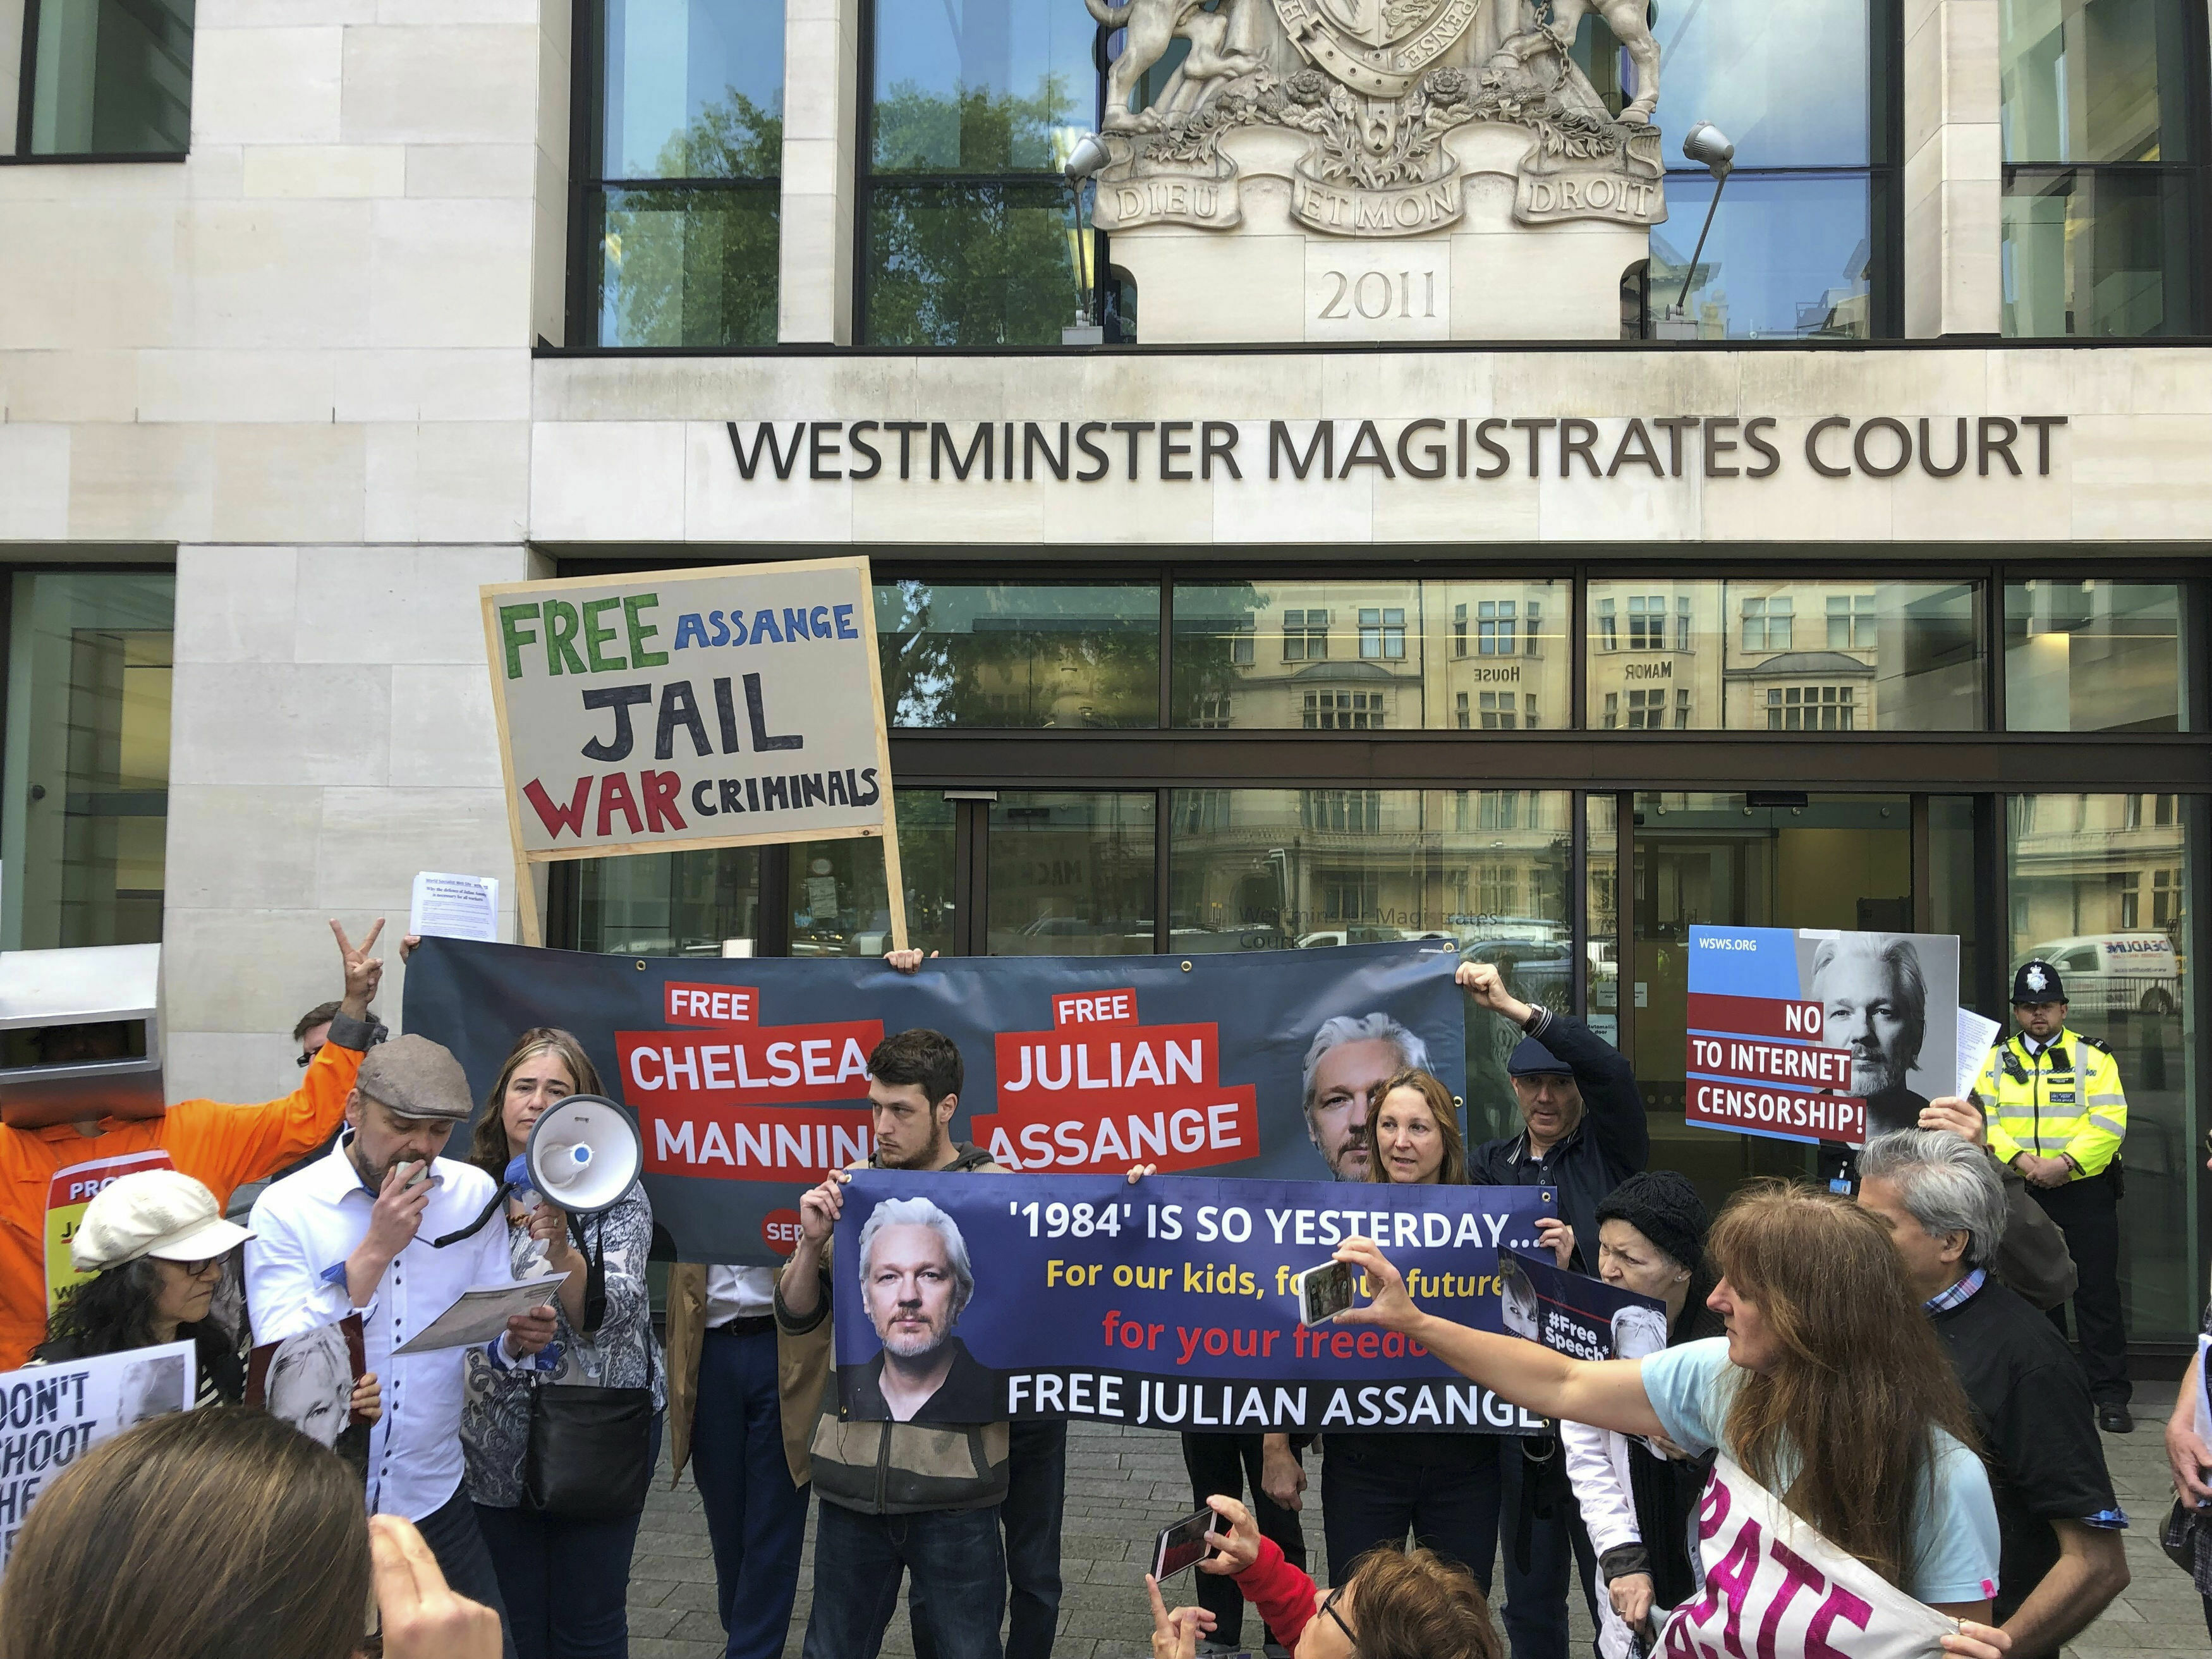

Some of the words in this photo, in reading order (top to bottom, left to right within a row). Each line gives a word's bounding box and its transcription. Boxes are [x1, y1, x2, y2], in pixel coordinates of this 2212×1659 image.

[1117, 182, 1220, 221] DIEU
[1528, 176, 1655, 218] DROIT
[1318, 270, 1437, 320] 2011
[727, 420, 1243, 482] WESTMINSTER
[1268, 417, 1781, 478] MAGISTRATES
[1806, 415, 2069, 478] COURT
[499, 593, 669, 679] FREE
[674, 604, 858, 650] ASSANGE
[581, 672, 804, 762] JAIL
[523, 769, 688, 840] WAR
[691, 767, 880, 817] CRIMINALS
[1699, 937, 1757, 952] WSWS.ORG
[671, 989, 750, 1021] FREE
[1059, 995, 1130, 1024] FREE
[1785, 1004, 1821, 1034] NO
[630, 1037, 873, 1091] CHELSEA
[1004, 1038, 1203, 1091] JULIAN
[1692, 1039, 1722, 1068] TO
[1730, 1043, 1850, 1083] INTERNET
[1697, 1086, 1864, 1134] CENSORSHIP!
[654, 1117, 876, 1169] MANNIN
[988, 1103, 1242, 1170] ASSANGE
[1009, 1201, 1132, 1240] '1984'
[1147, 1204, 1183, 1240] IS
[1196, 1206, 1253, 1243] SO
[1047, 1259, 1102, 1288] For
[1112, 1267, 1172, 1291] our
[1182, 1261, 1265, 1301] kids,
[1275, 1265, 1300, 1296] fo
[1102, 1310, 1165, 1351] for
[1176, 1326, 1279, 1364] your
[1293, 1322, 1430, 1358] freedo
[1548, 1311, 1597, 1345] #Free
[1009, 1373, 1124, 1418] FREE
[1136, 1381, 1306, 1427] JULIAN
[0, 1420, 97, 1478] HOOT
